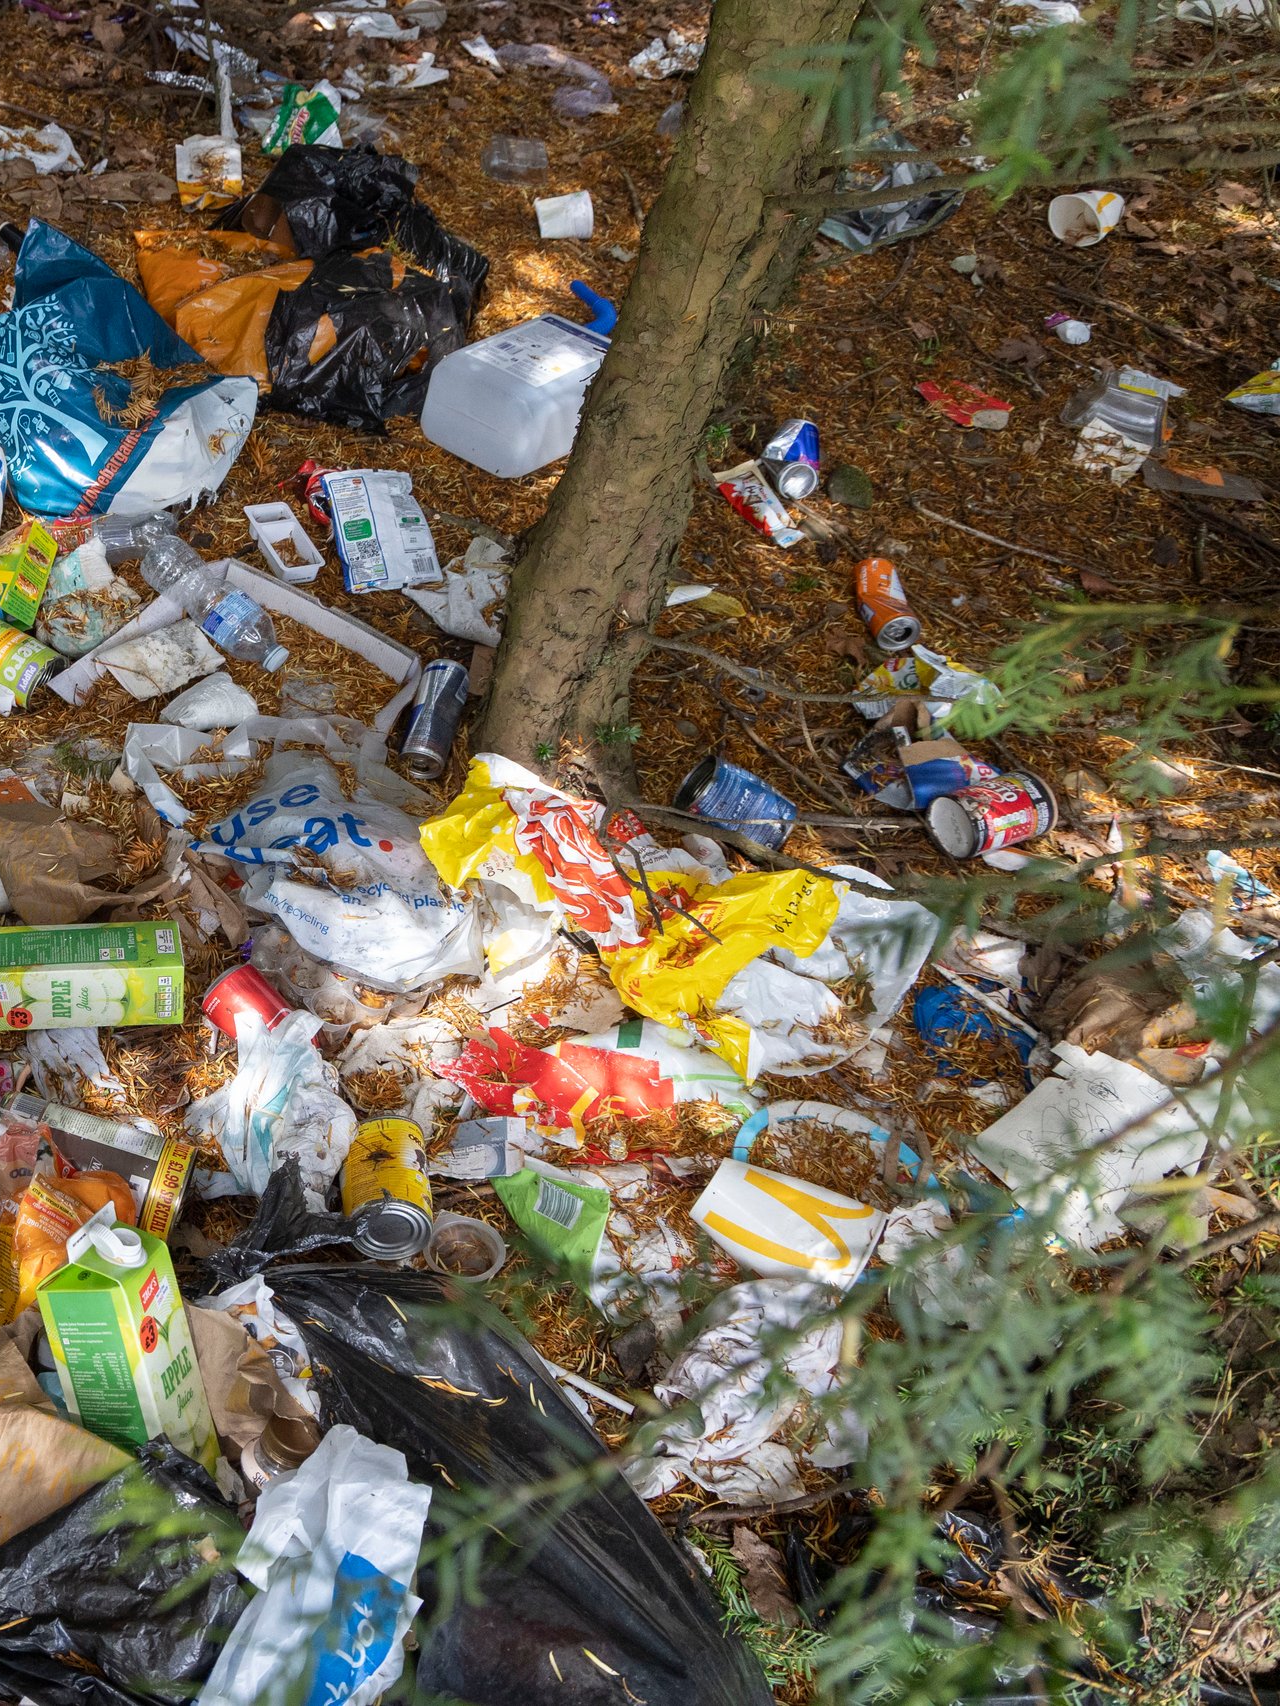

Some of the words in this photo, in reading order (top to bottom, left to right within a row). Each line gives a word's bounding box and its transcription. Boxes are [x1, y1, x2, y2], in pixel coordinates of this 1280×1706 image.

[19, 664, 37, 691] PUPPY
[211, 784, 320, 847] use
[50, 979, 72, 1018] APPLE
[75, 985, 89, 1013] Juice
[14, 1010, 29, 1025] £3
[163, 1160, 185, 1189] £1.99
[150, 1187, 175, 1234] SPECIAL
[142, 1275, 158, 1306] JACK'S
[145, 1323, 156, 1350] £3
[160, 1346, 192, 1400] APPLE
[275, 1355, 285, 1368] NO
[177, 1389, 194, 1419] Juice
